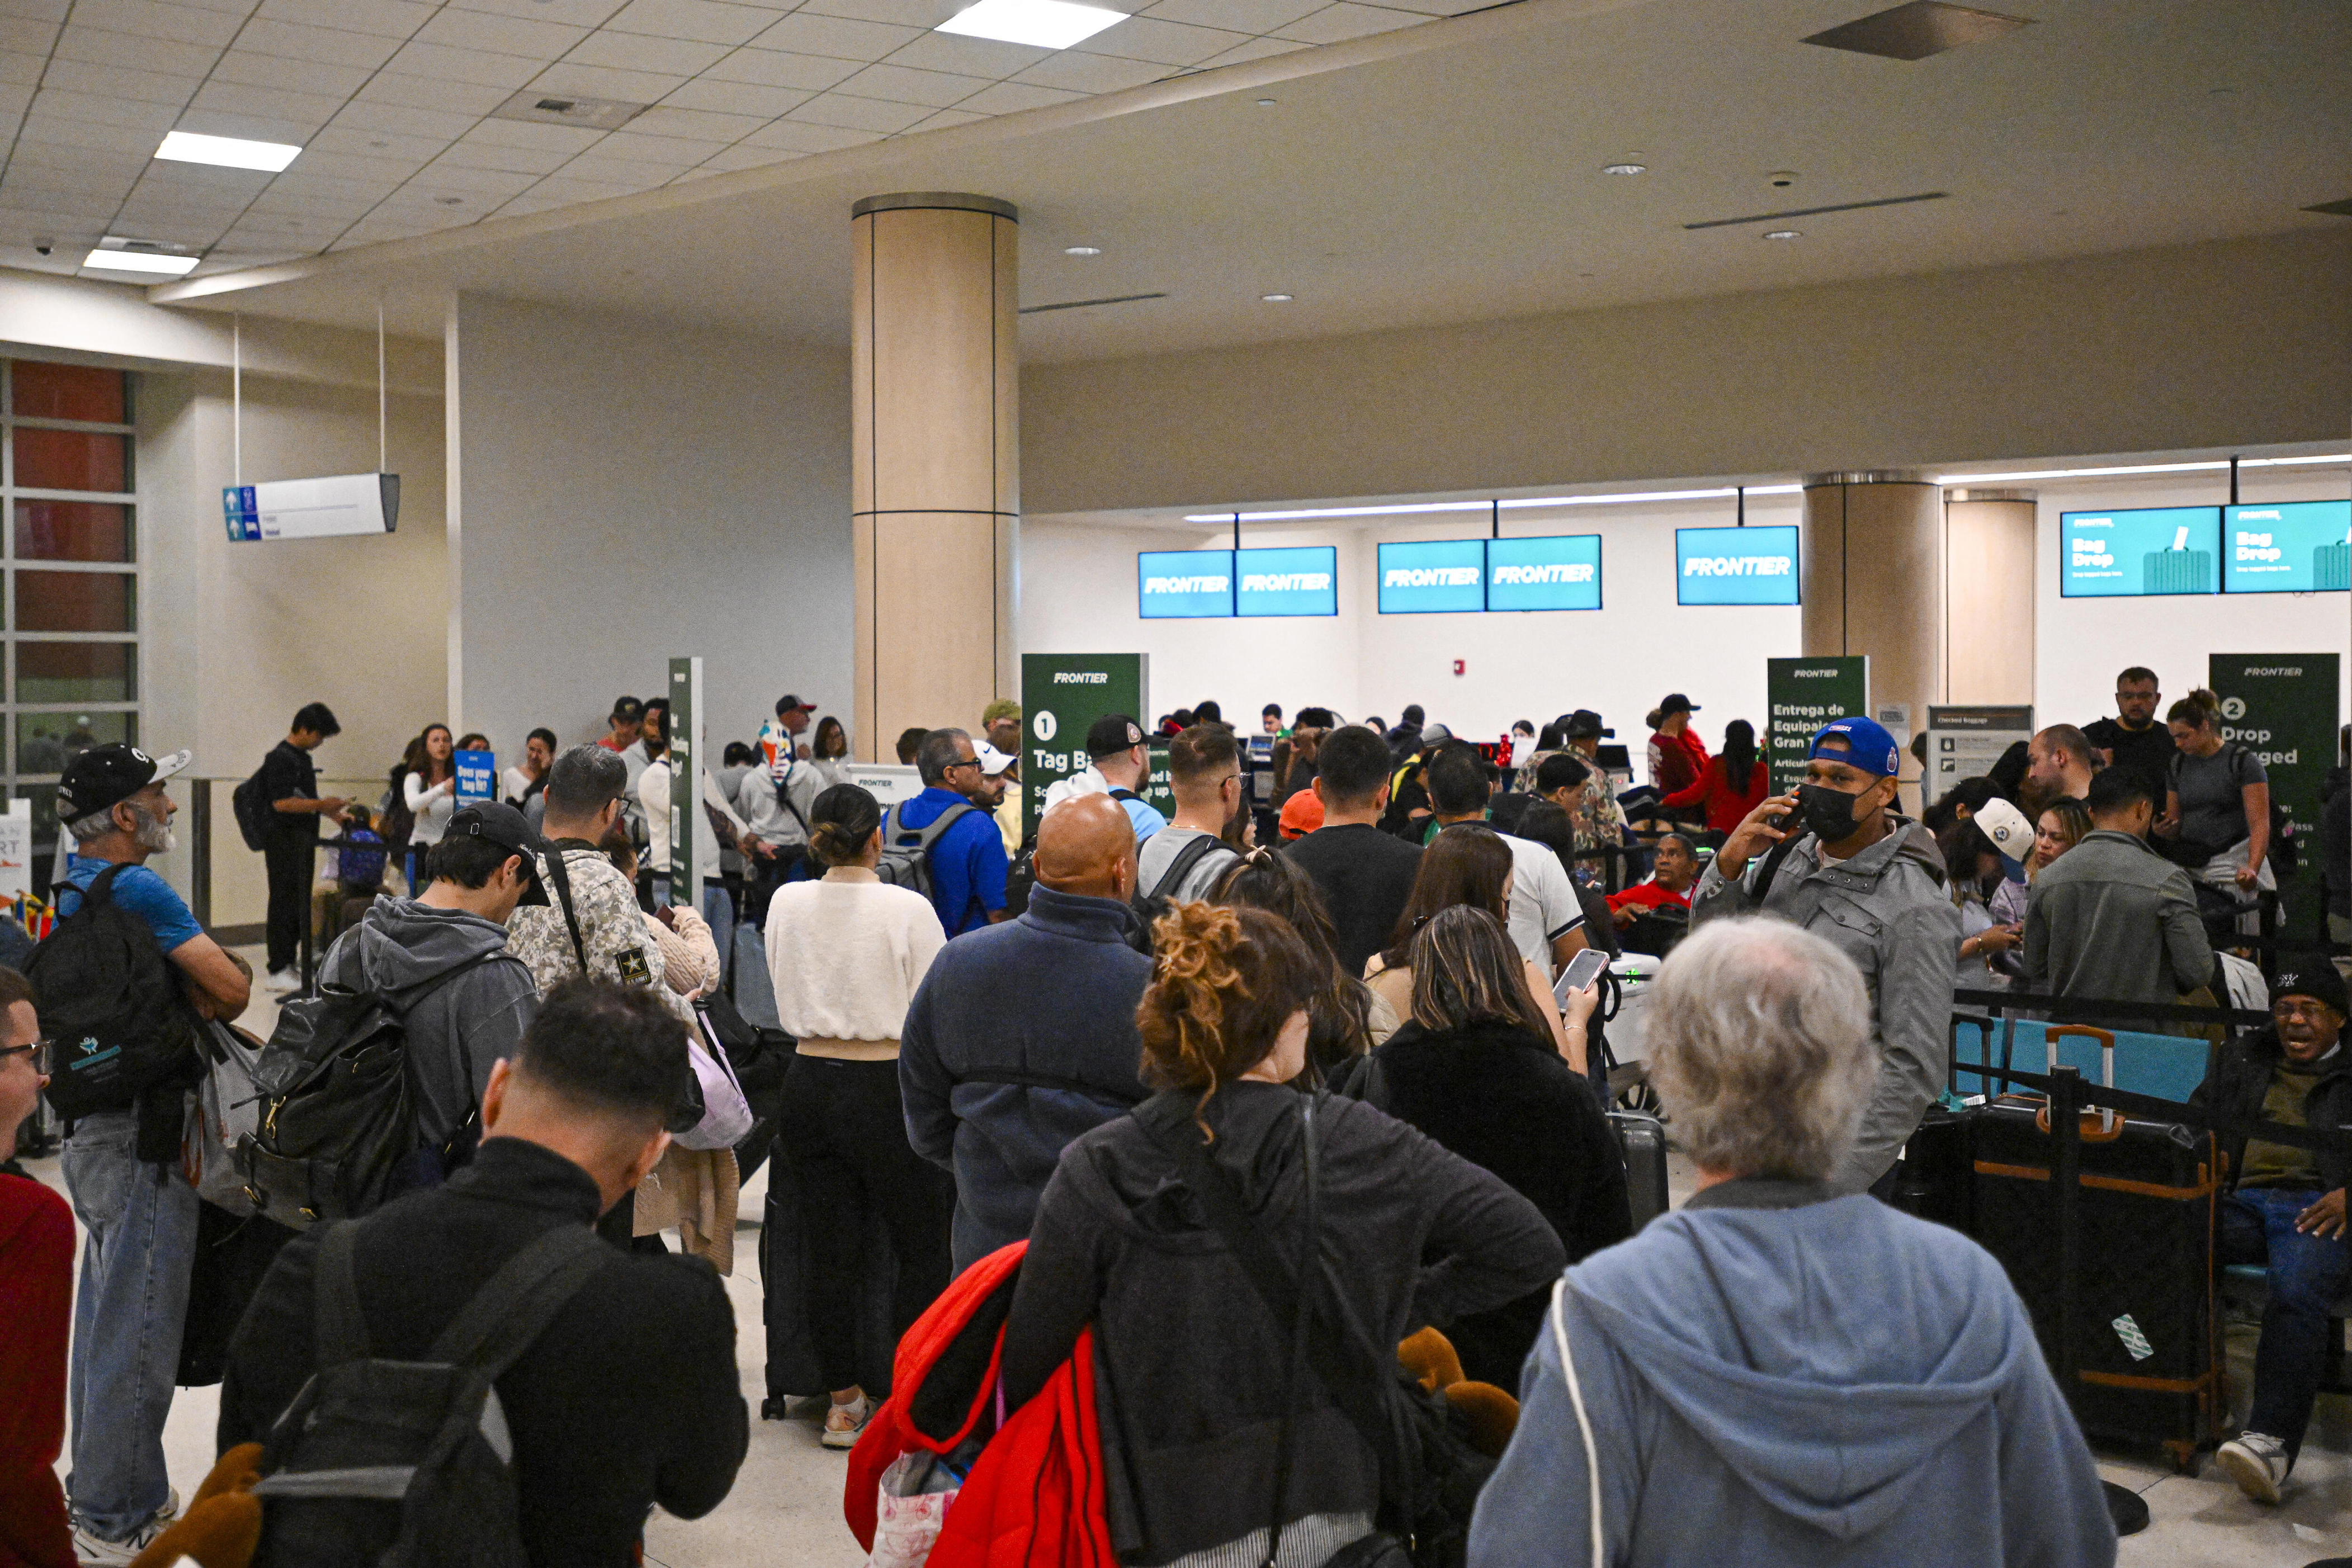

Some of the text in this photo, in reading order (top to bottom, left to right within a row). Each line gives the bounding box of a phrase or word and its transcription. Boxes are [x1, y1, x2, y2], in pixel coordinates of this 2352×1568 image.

[2072, 538, 2105, 554] Bag
[2236, 531, 2272, 547] Bag
[2072, 552, 2114, 568] Drop
[2236, 546, 2282, 562] Drop
[1493, 563, 1595, 585] FRONTIER
[1683, 555, 1791, 577] FRONTIER
[1144, 575, 1229, 594] FRONTIER
[1241, 573, 1331, 592] FRONTIER
[1385, 566, 1480, 588] FRONTIER
[1053, 673, 1108, 684] FRONTIER
[1794, 669, 1839, 678] FRONTIER
[2244, 667, 2303, 677] FRONTIER
[1773, 703, 1845, 718] Entrega de
[2227, 702, 2238, 715] 2
[1041, 718, 1047, 734] 1
[1774, 736, 1805, 748] Gran
[2221, 726, 2271, 744] Drop
[1033, 749, 1068, 773] Tag
